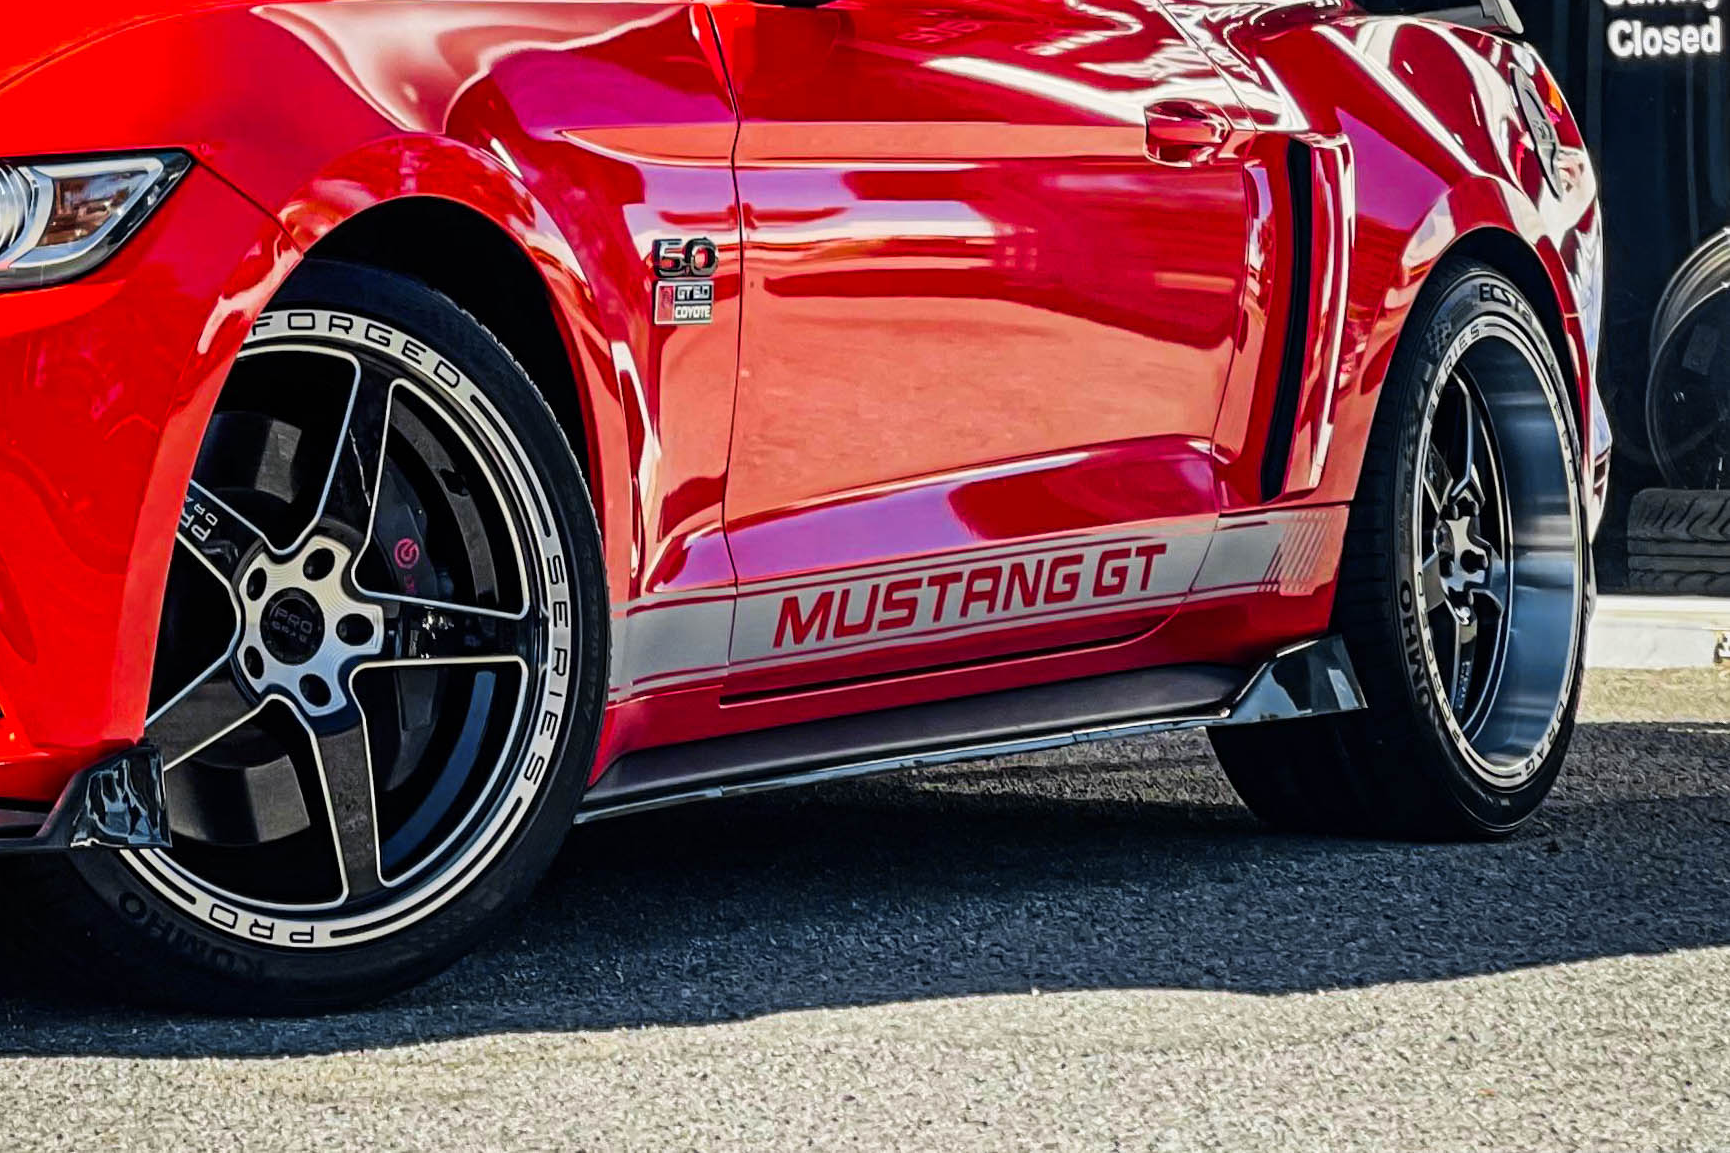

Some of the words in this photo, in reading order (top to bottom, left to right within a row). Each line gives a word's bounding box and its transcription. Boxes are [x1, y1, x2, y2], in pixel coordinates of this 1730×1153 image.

[1607, 14, 1723, 59] Closed
[675, 304, 711, 319] COYOTE
[677, 286, 693, 300] GT
[252, 312, 460, 389] FORGED
[772, 547, 1089, 649] MUSTANG
[1091, 543, 1168, 598] GT
[273, 606, 314, 635] PRO
[522, 553, 569, 786] SERIES
[1525, 700, 1567, 776] DRAG
[208, 902, 315, 944] PRO
